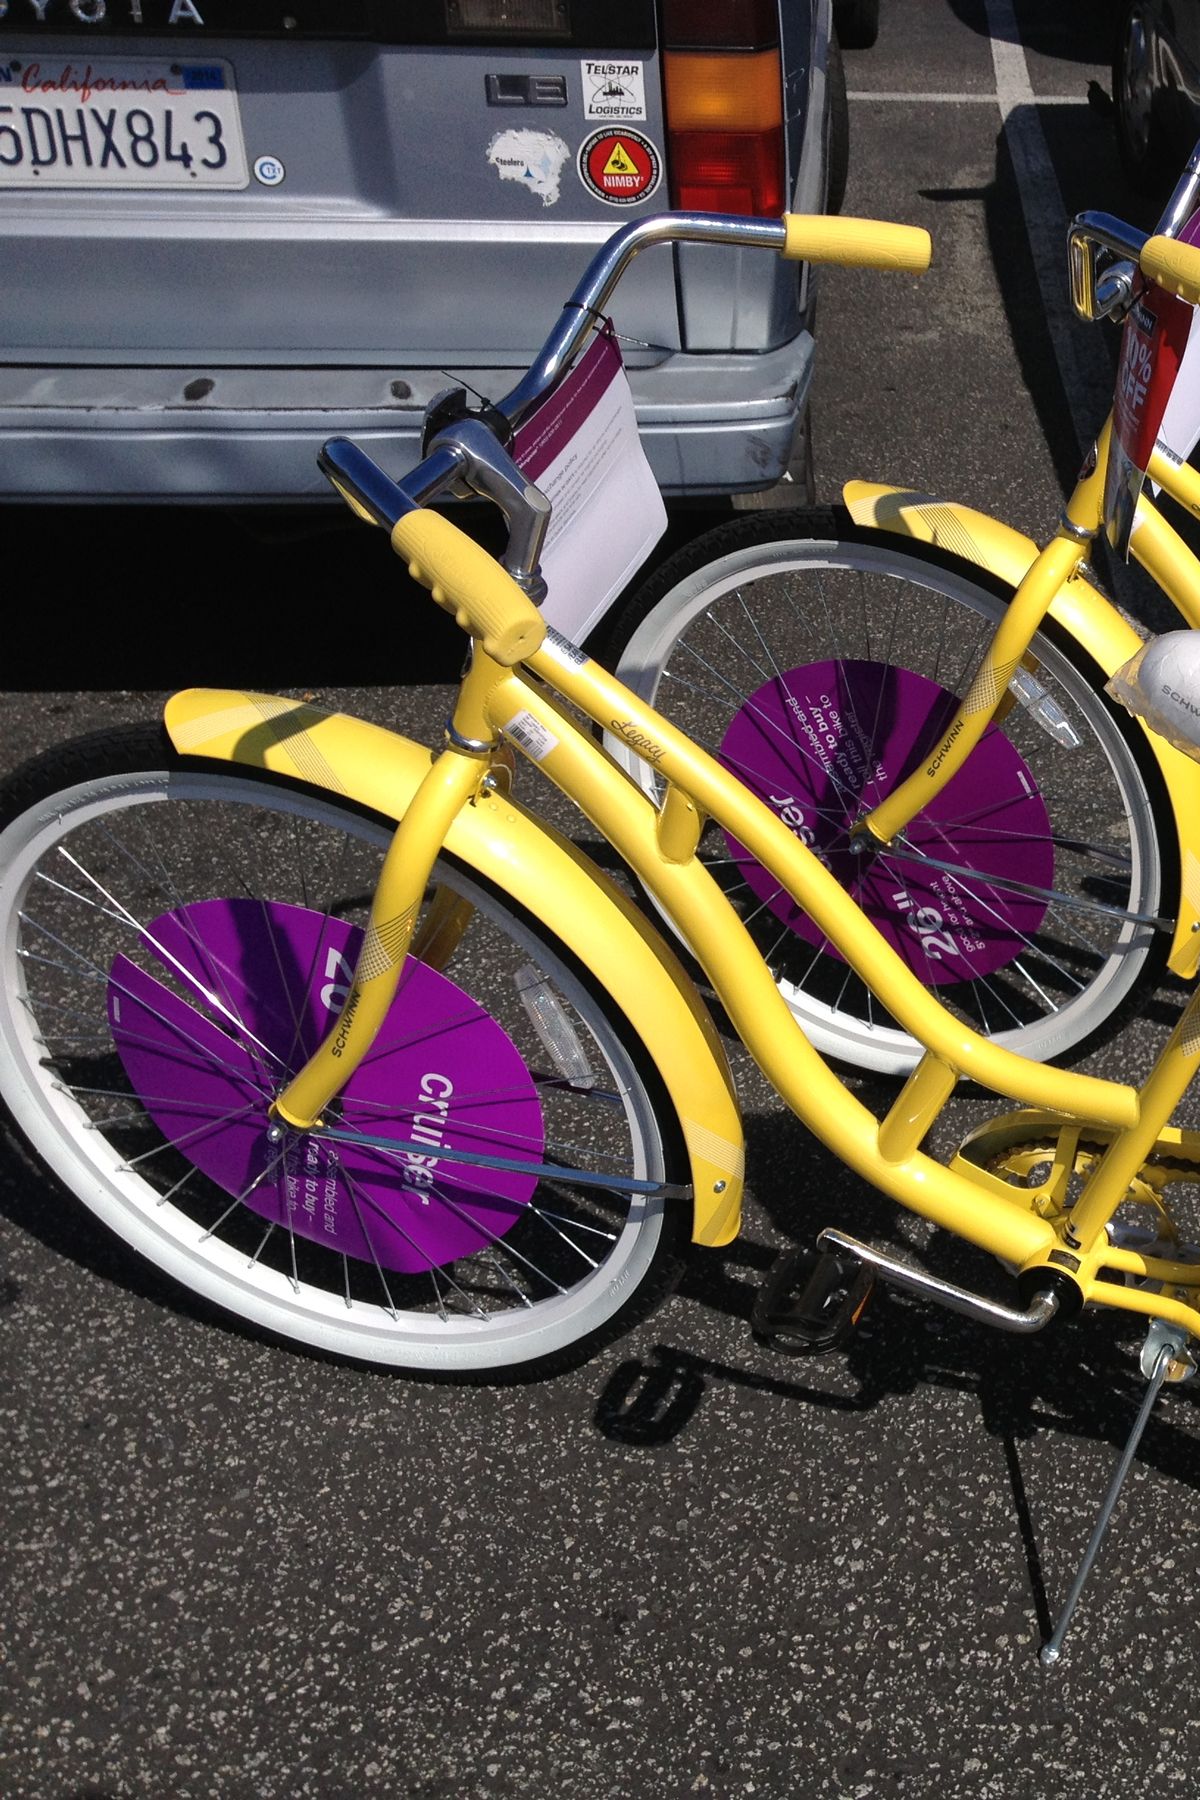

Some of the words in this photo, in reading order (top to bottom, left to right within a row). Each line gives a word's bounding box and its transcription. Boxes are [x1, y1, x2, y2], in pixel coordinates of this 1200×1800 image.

[0, 0, 204, 25] YOTA
[21, 63, 187, 103] California
[586, 63, 639, 76] TELSTAR
[488, 75, 566, 103] LE
[588, 104, 643, 115] LOGISTICS
[0, 107, 228, 169] 5DHX843
[603, 176, 641, 188] NIMBY
[1127, 326, 1152, 383] 10%
[785, 697, 807, 724] and
[820, 695, 833, 709] to
[809, 706, 829, 733] buy
[828, 711, 848, 739] bike
[611, 720, 667, 764] Legacy
[826, 734, 839, 750] to
[845, 740, 862, 763] this
[927, 720, 964, 778] SCHWINN
[802, 724, 848, 794] assembled
[834, 751, 861, 790] ready
[872, 759, 888, 782] the
[332, 991, 361, 1059] SCHWINN
[400, 1072, 454, 1206] cruiser
[303, 1141, 320, 1179] ready
[286, 1175, 300, 1198] bike
[305, 1179, 319, 1193] to
[324, 1150, 339, 1214] assembled
[302, 1193, 319, 1216] buy
[323, 1213, 337, 1235] and
